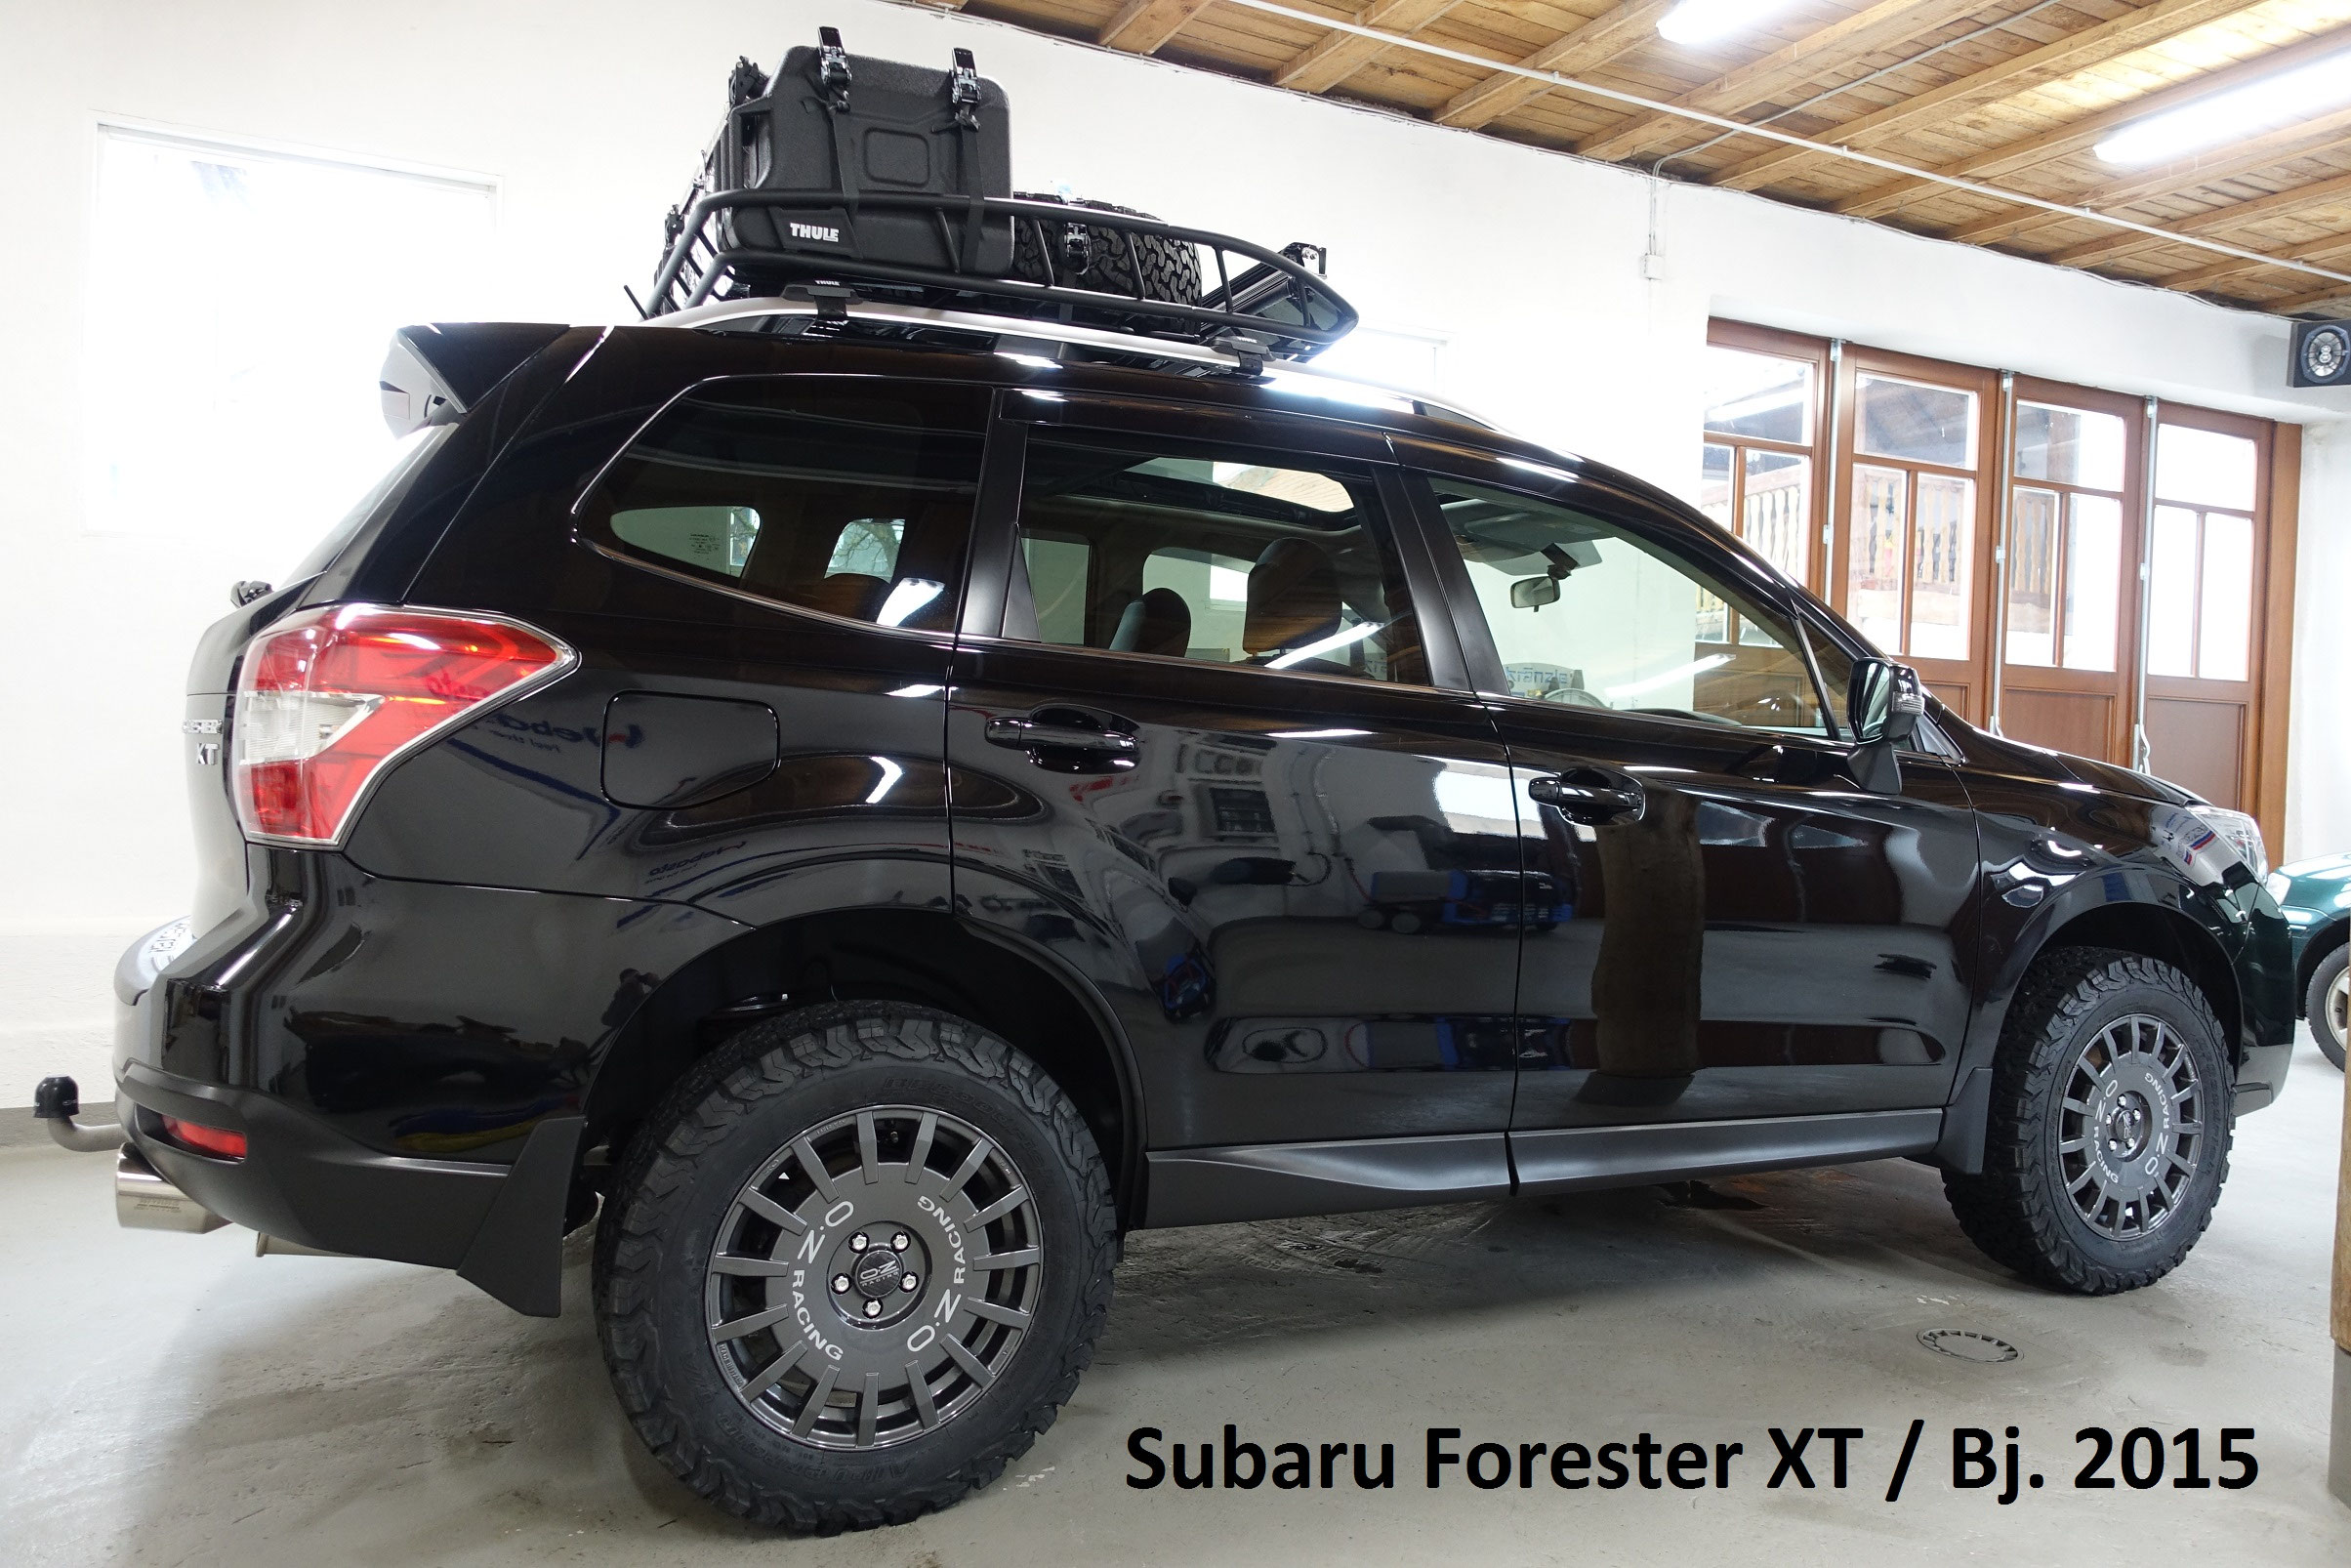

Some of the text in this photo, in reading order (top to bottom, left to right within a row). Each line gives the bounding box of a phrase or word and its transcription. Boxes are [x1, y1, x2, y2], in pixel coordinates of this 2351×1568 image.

[790, 222, 840, 243] THULE
[196, 742, 220, 765] XT
[2144, 1072, 2169, 1129] RACING
[2093, 1126, 2119, 1183] RACING
[917, 1195, 967, 1284] RACING
[862, 1271, 899, 1287] RACING
[792, 1269, 844, 1361] RACING
